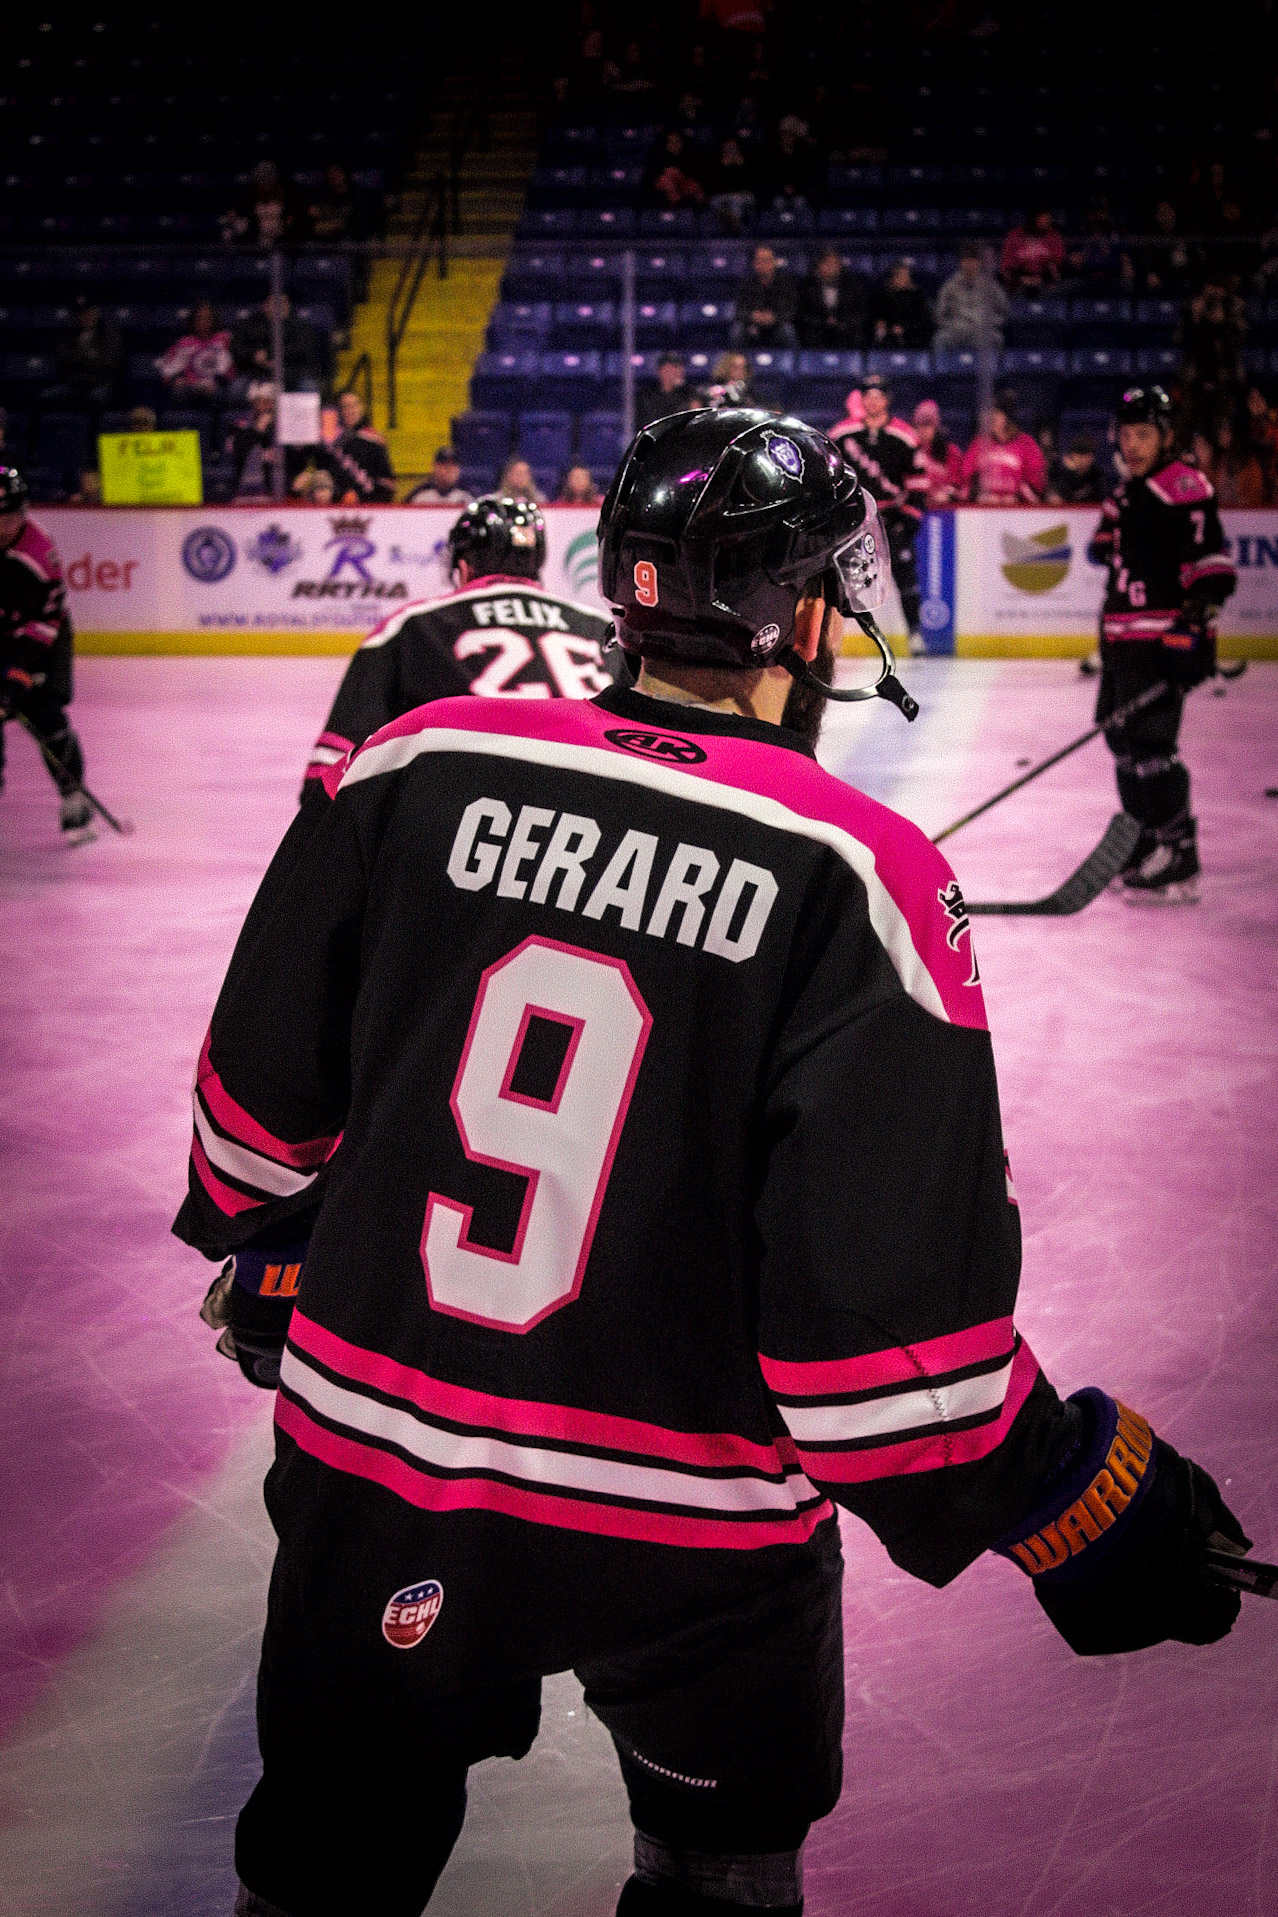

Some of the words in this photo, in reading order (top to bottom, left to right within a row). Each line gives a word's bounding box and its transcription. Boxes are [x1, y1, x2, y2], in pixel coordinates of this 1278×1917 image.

[633, 560, 659, 607] 9
[471, 598, 570, 631] FELIX
[453, 627, 615, 700] 26
[446, 797, 779, 963] GERARD
[419, 934, 654, 1335] 9
[384, 1596, 440, 1625] ECHL
